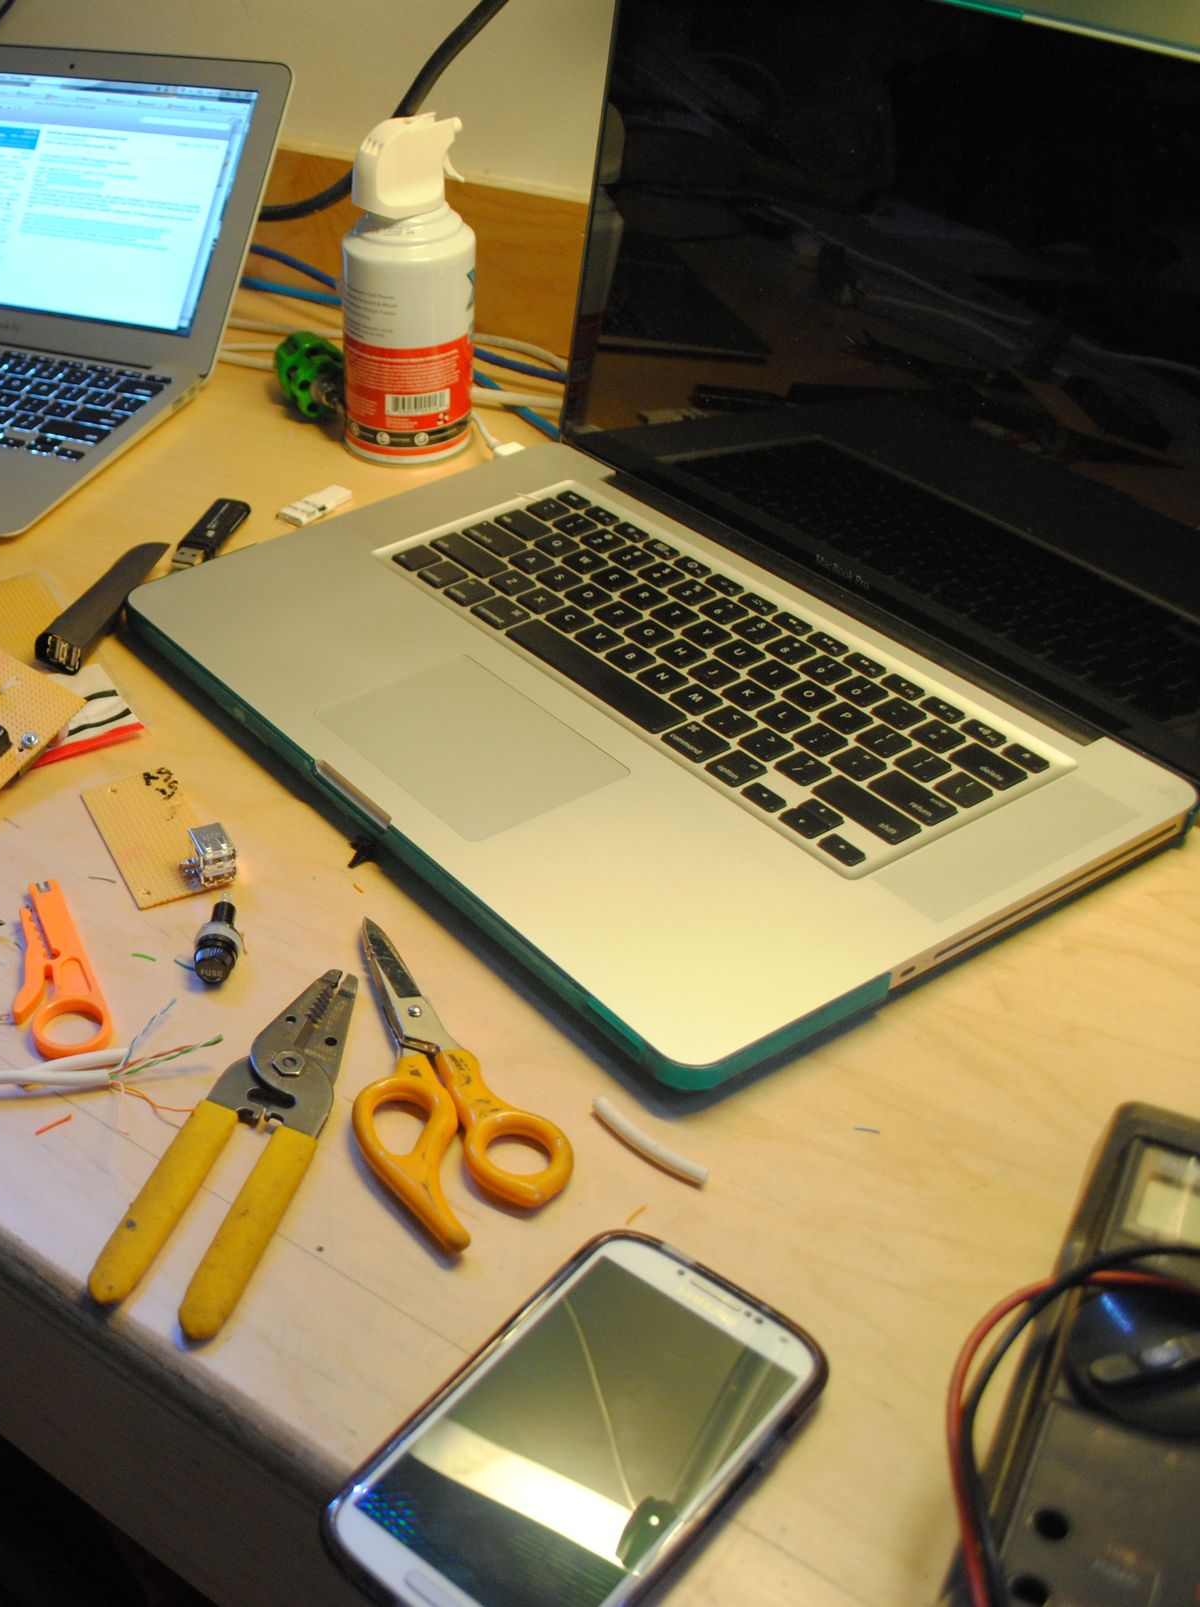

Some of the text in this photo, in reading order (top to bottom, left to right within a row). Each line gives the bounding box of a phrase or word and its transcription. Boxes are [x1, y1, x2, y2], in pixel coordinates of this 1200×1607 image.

[816, 553, 870, 591] MacBook Pro
[669, 733, 704, 755] command
[716, 764, 740, 780] option
[978, 765, 1004, 782] delete
[908, 801, 933, 818] return
[877, 822, 898, 835] shift
[200, 967, 223, 978] FUSE
